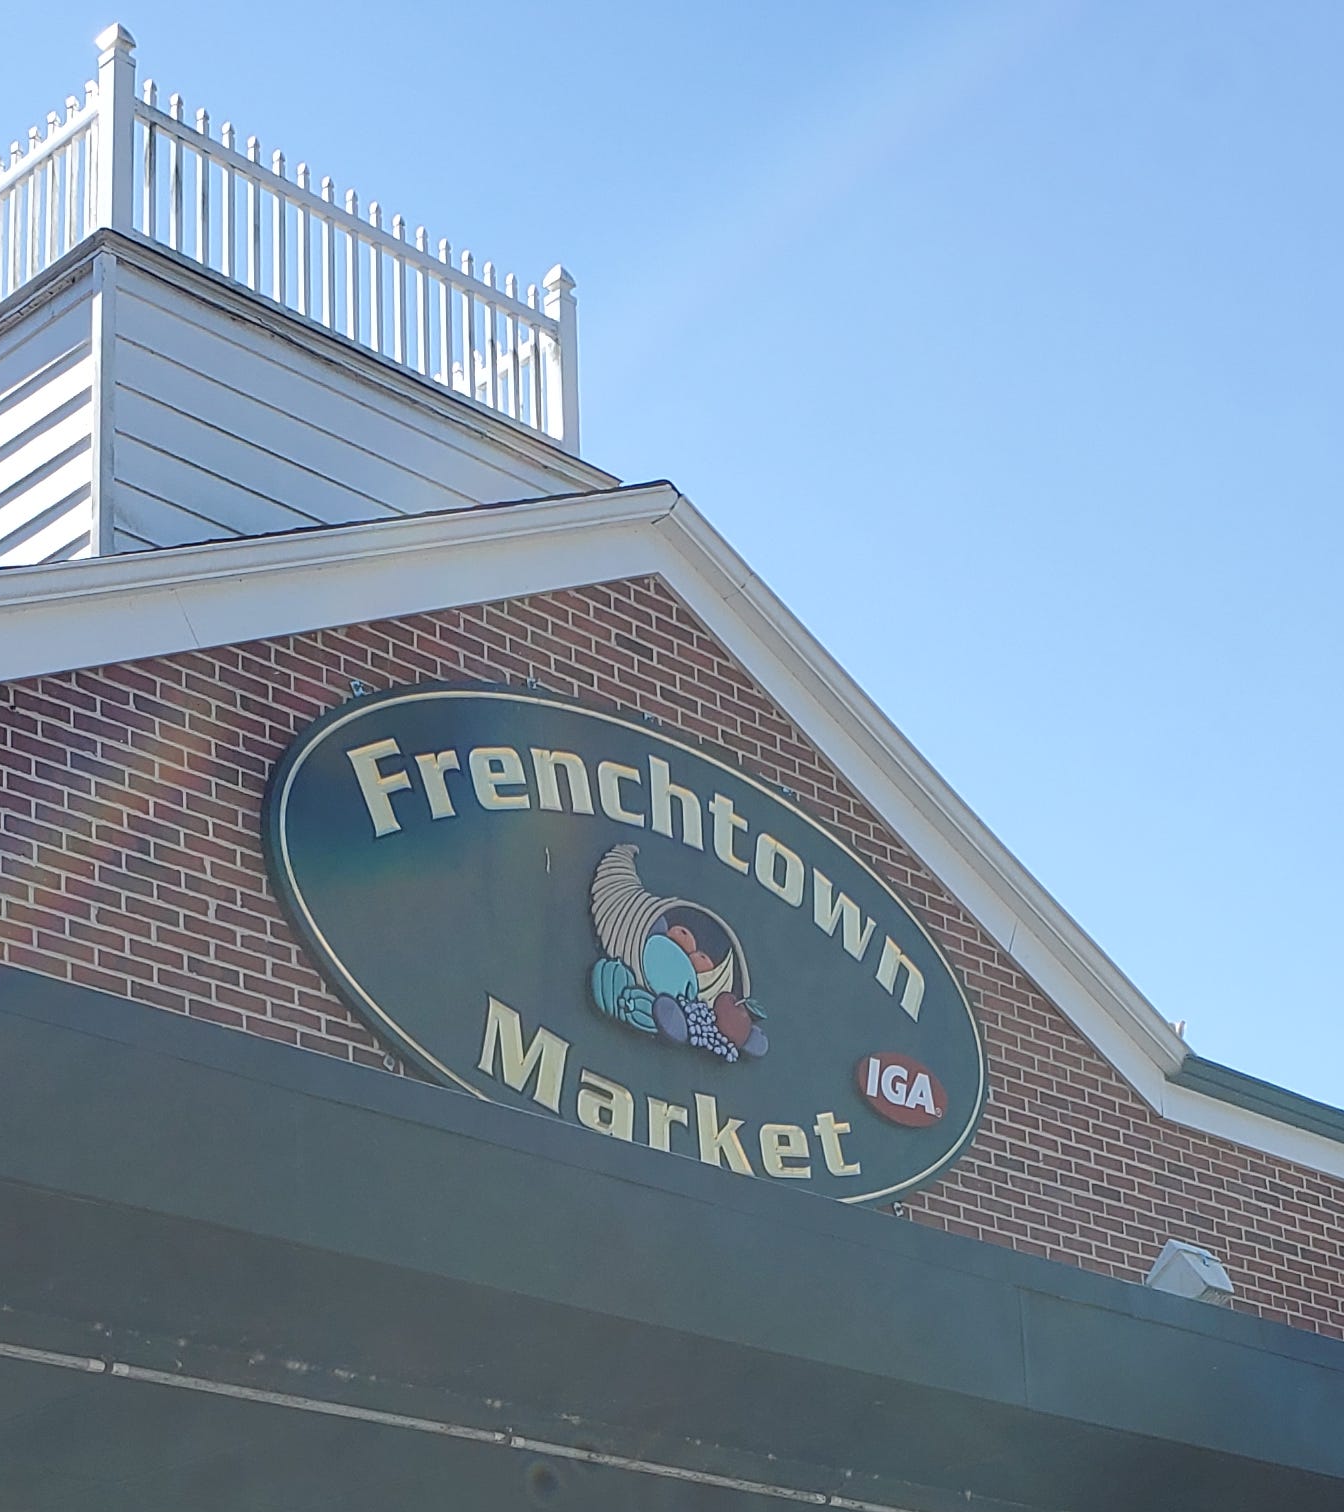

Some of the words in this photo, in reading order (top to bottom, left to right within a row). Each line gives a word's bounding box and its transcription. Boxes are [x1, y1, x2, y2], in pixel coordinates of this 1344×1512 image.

[345, 737, 927, 1023] Frenchtown
[477, 994, 862, 1180] Market
[866, 1056, 936, 1116] IGA
